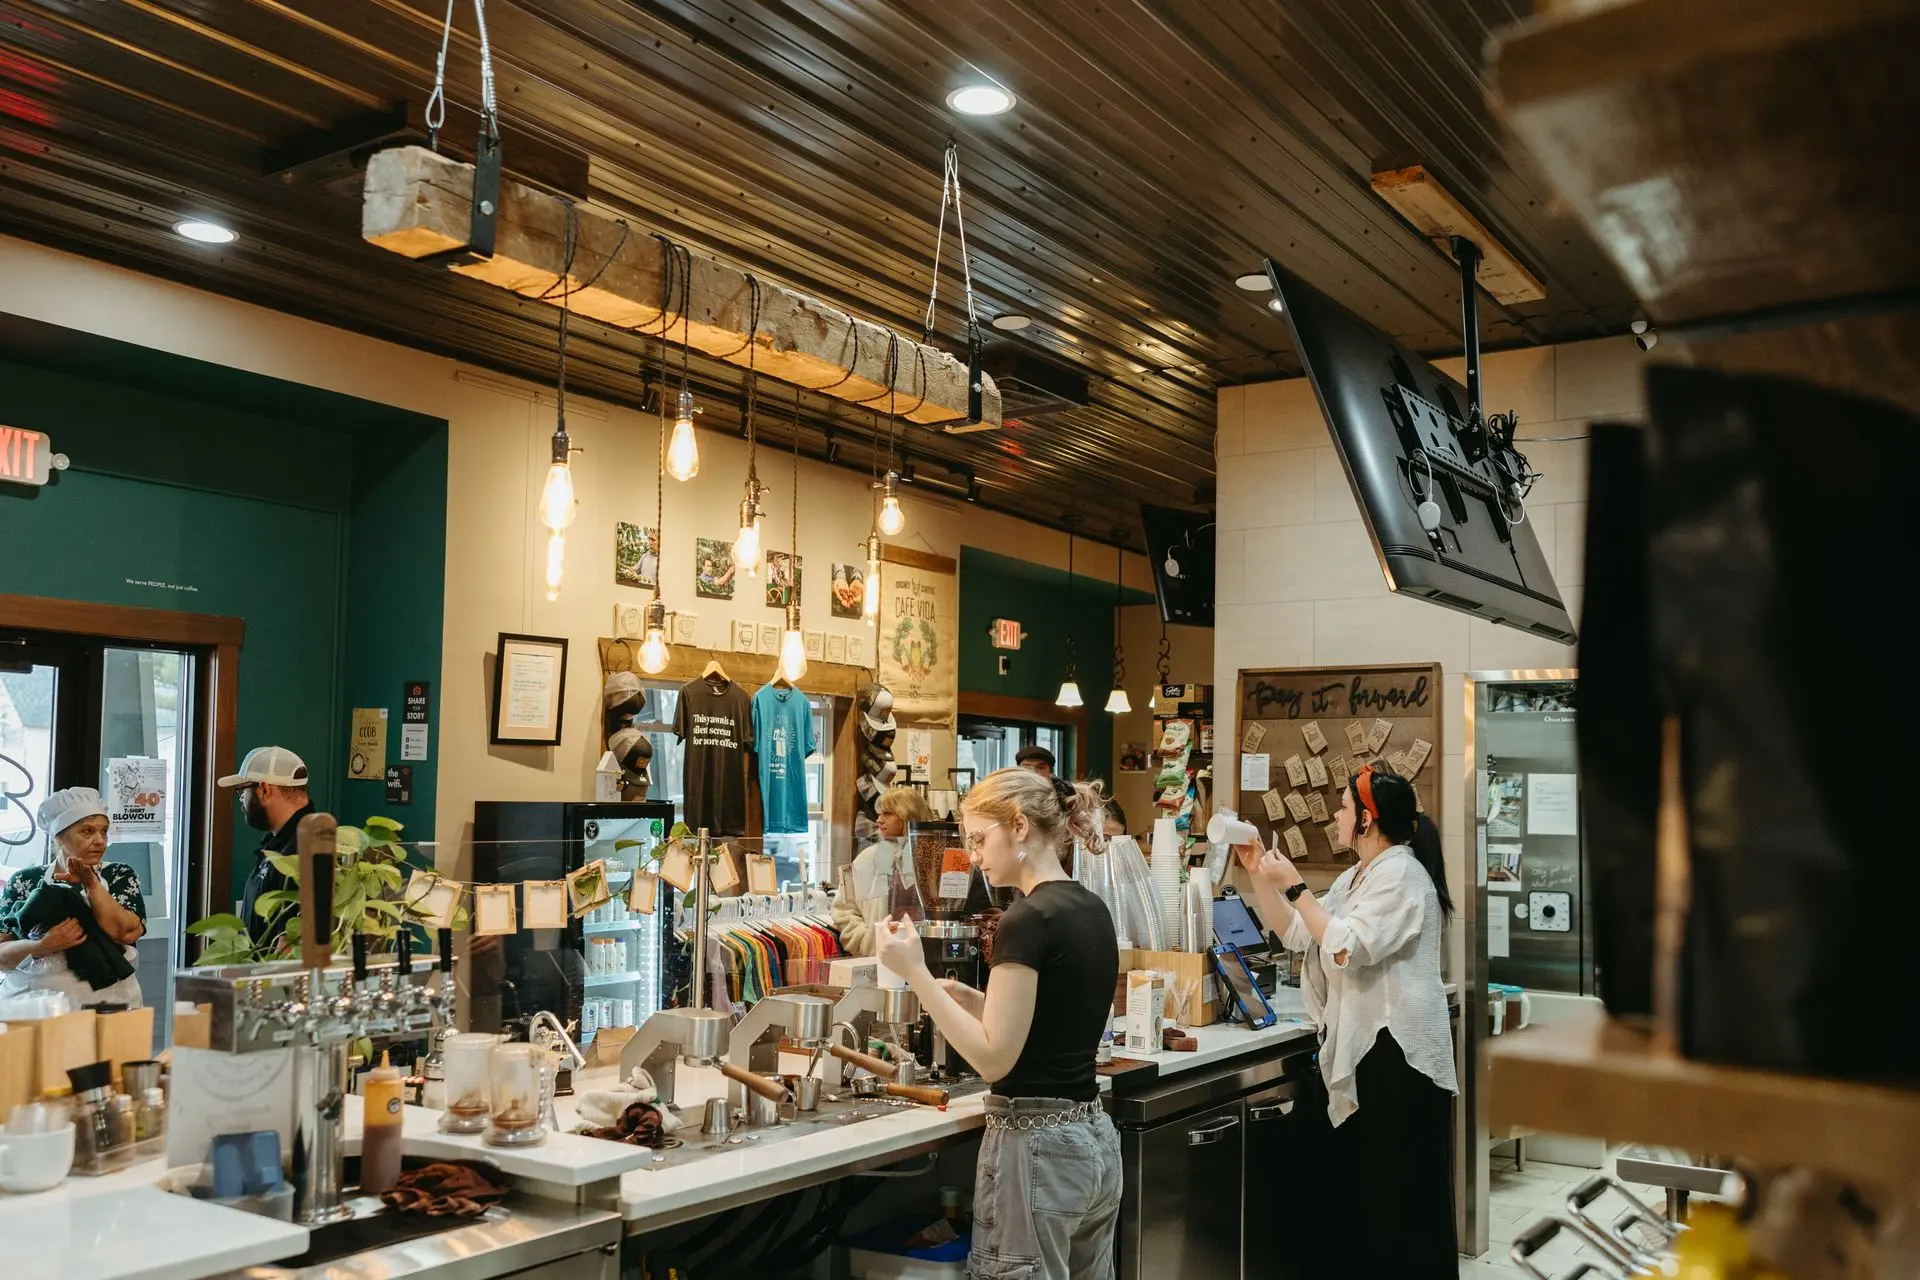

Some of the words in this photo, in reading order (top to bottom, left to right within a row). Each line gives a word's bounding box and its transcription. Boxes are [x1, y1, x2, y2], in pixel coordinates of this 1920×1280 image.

[0, 427, 40, 480] XIT
[125, 577, 134, 585] We
[917, 599, 936, 622] VIDA
[999, 620, 1017, 647] EXIT
[407, 697, 426, 705] SHARE
[1311, 682, 1346, 714] it
[1349, 675, 1429, 716] forward
[406, 712, 425, 720] STORY
[693, 714, 707, 723] This
[706, 716, 724, 726] yawn
[359, 726, 377, 738] CLUB
[387, 768, 399, 778] the
[387, 778, 402, 788] wifi.
[112, 813, 155, 821] BLOWOUT
